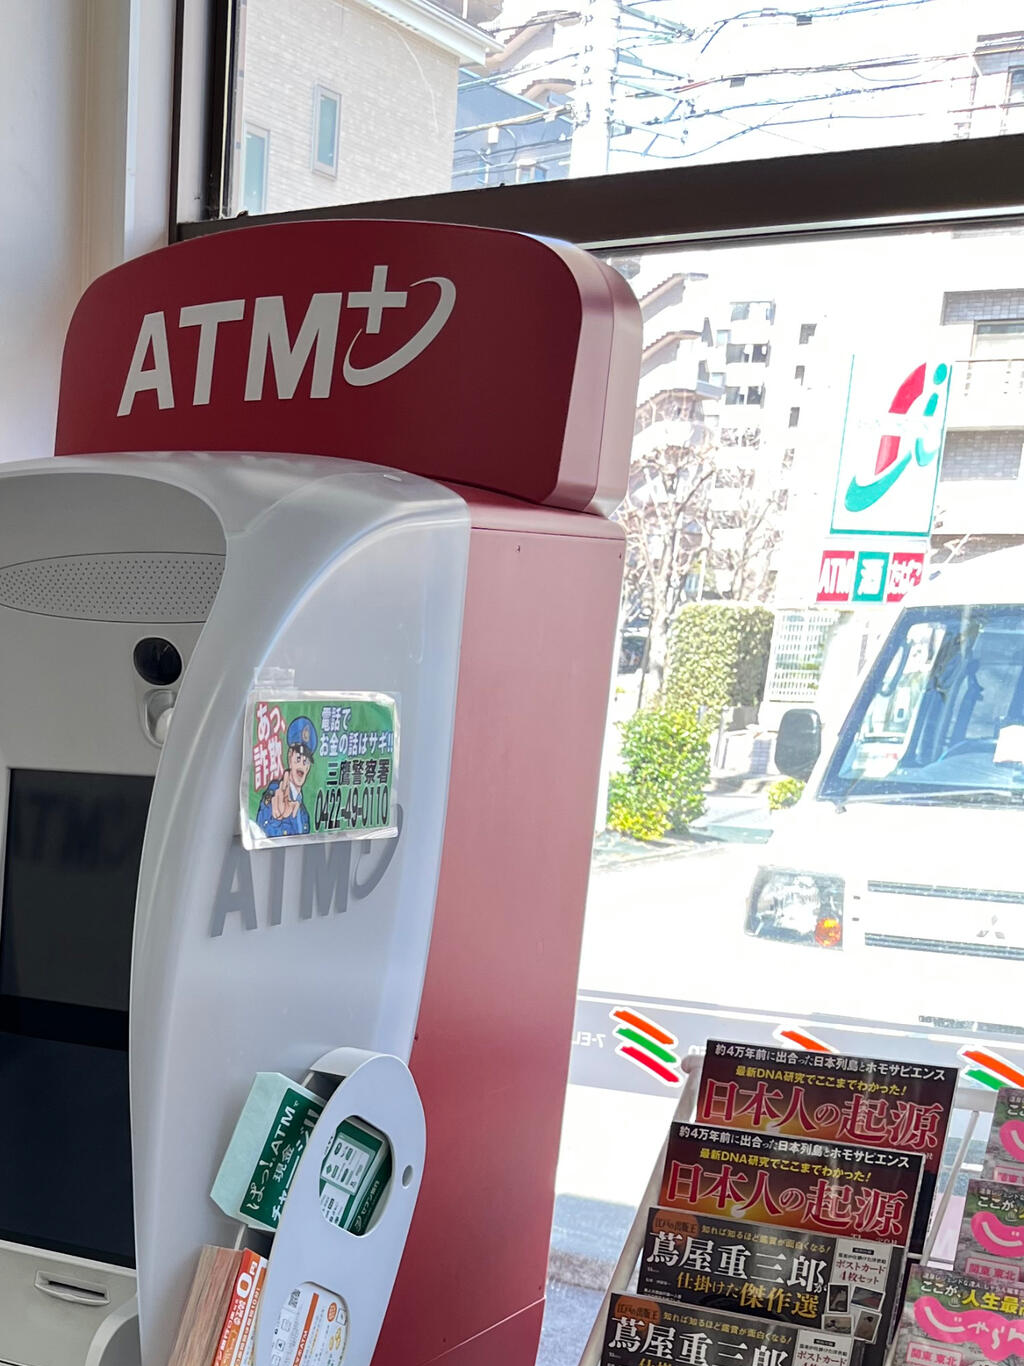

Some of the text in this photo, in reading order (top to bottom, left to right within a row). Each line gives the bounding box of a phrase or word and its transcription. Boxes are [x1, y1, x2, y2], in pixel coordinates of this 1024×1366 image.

[321, 706, 352, 731] 電話で
[326, 759, 390, 787] 三鷹警察署
[314, 785, 390, 832] 0422-49-0110
[702, 1078, 944, 1151] 日本人の起源
[273, 1143, 294, 1183] 現金
[667, 1160, 907, 1237] 日本人の起源
[677, 1271, 819, 1320] 仕掛けた傑作選
